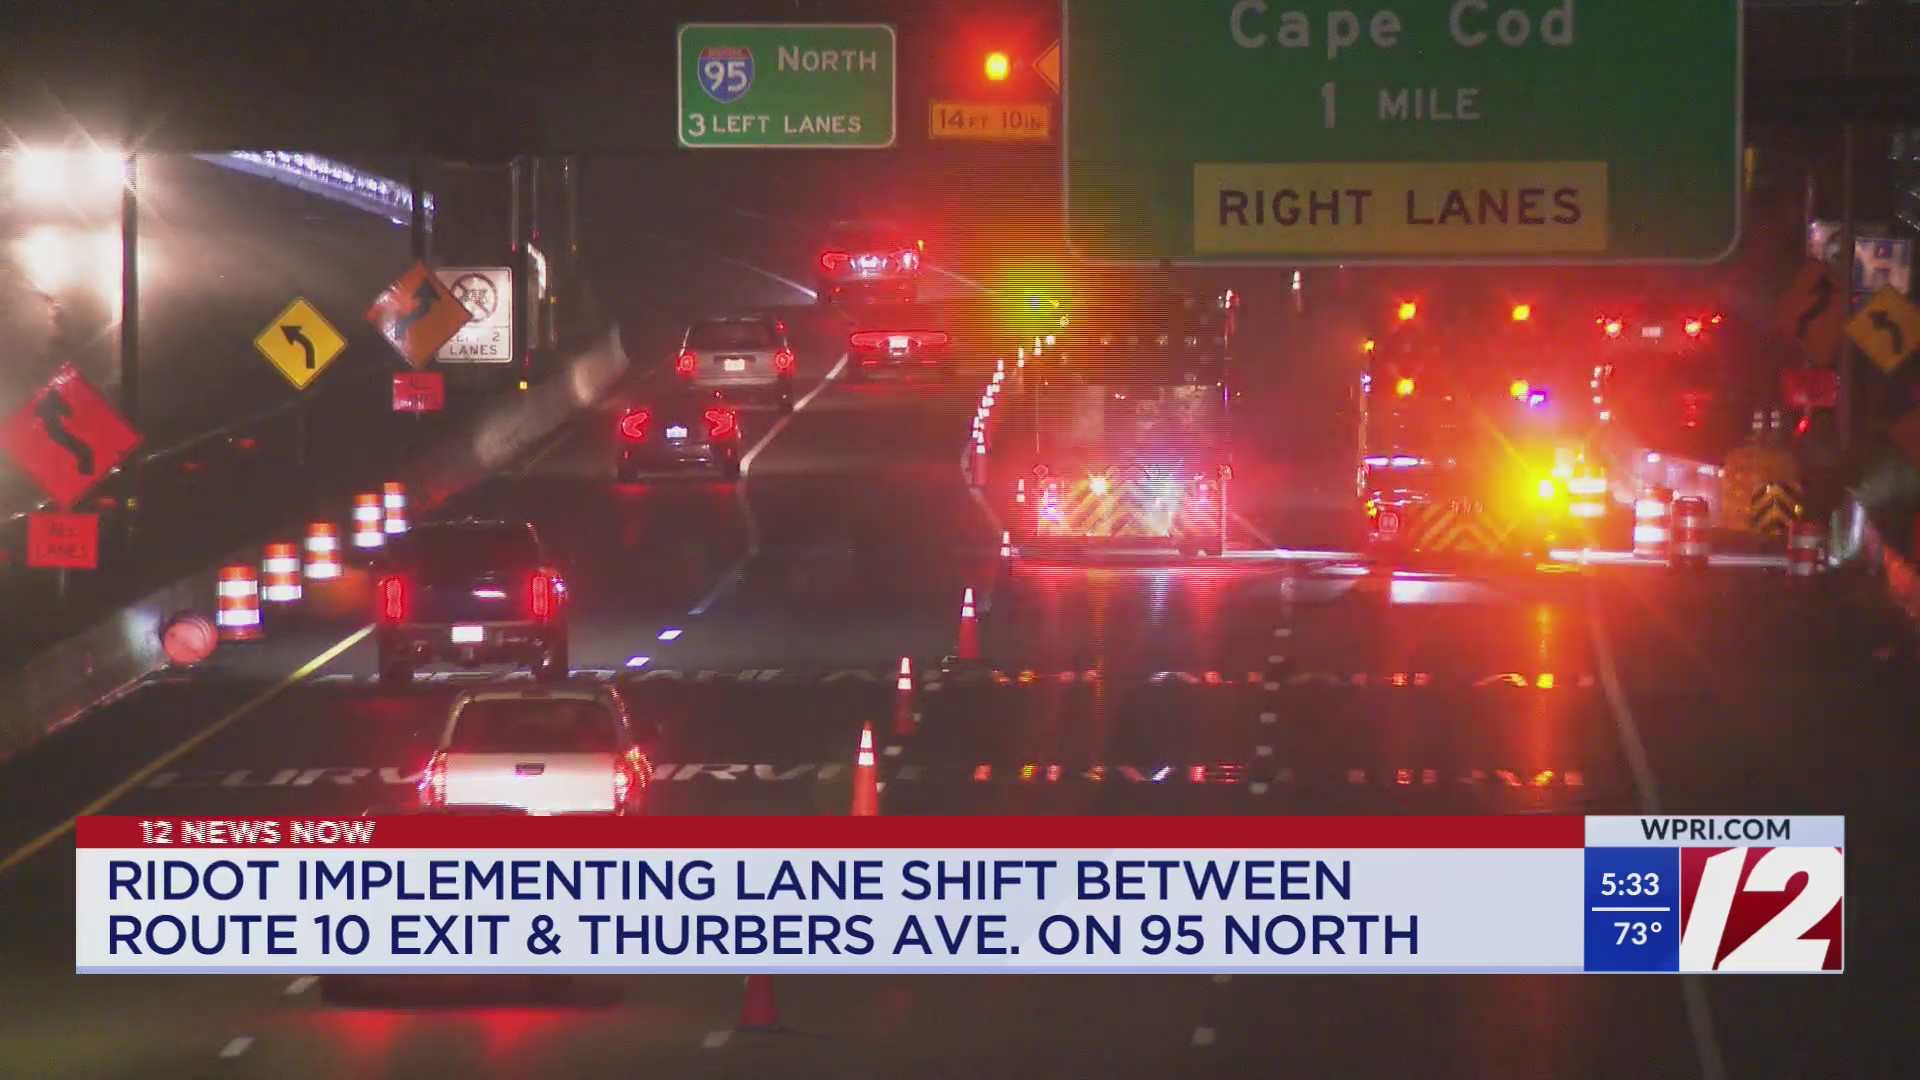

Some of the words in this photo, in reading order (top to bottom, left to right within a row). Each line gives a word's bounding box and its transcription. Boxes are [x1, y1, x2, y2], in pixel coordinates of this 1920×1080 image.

[1230, 0, 1402, 60] Cape
[1449, 0, 1575, 47] Cod
[703, 60, 750, 93] 95
[1320, 81, 1337, 129] 1
[1378, 87, 1481, 121] MILE
[688, 113, 706, 137] 3
[712, 114, 770, 135] LEFT
[783, 114, 862, 135] LANES
[1218, 188, 1373, 227] RIGHT
[1406, 187, 1582, 226] LANES
[449, 344, 498, 356] LANES
[492, 331, 501, 342] 2
